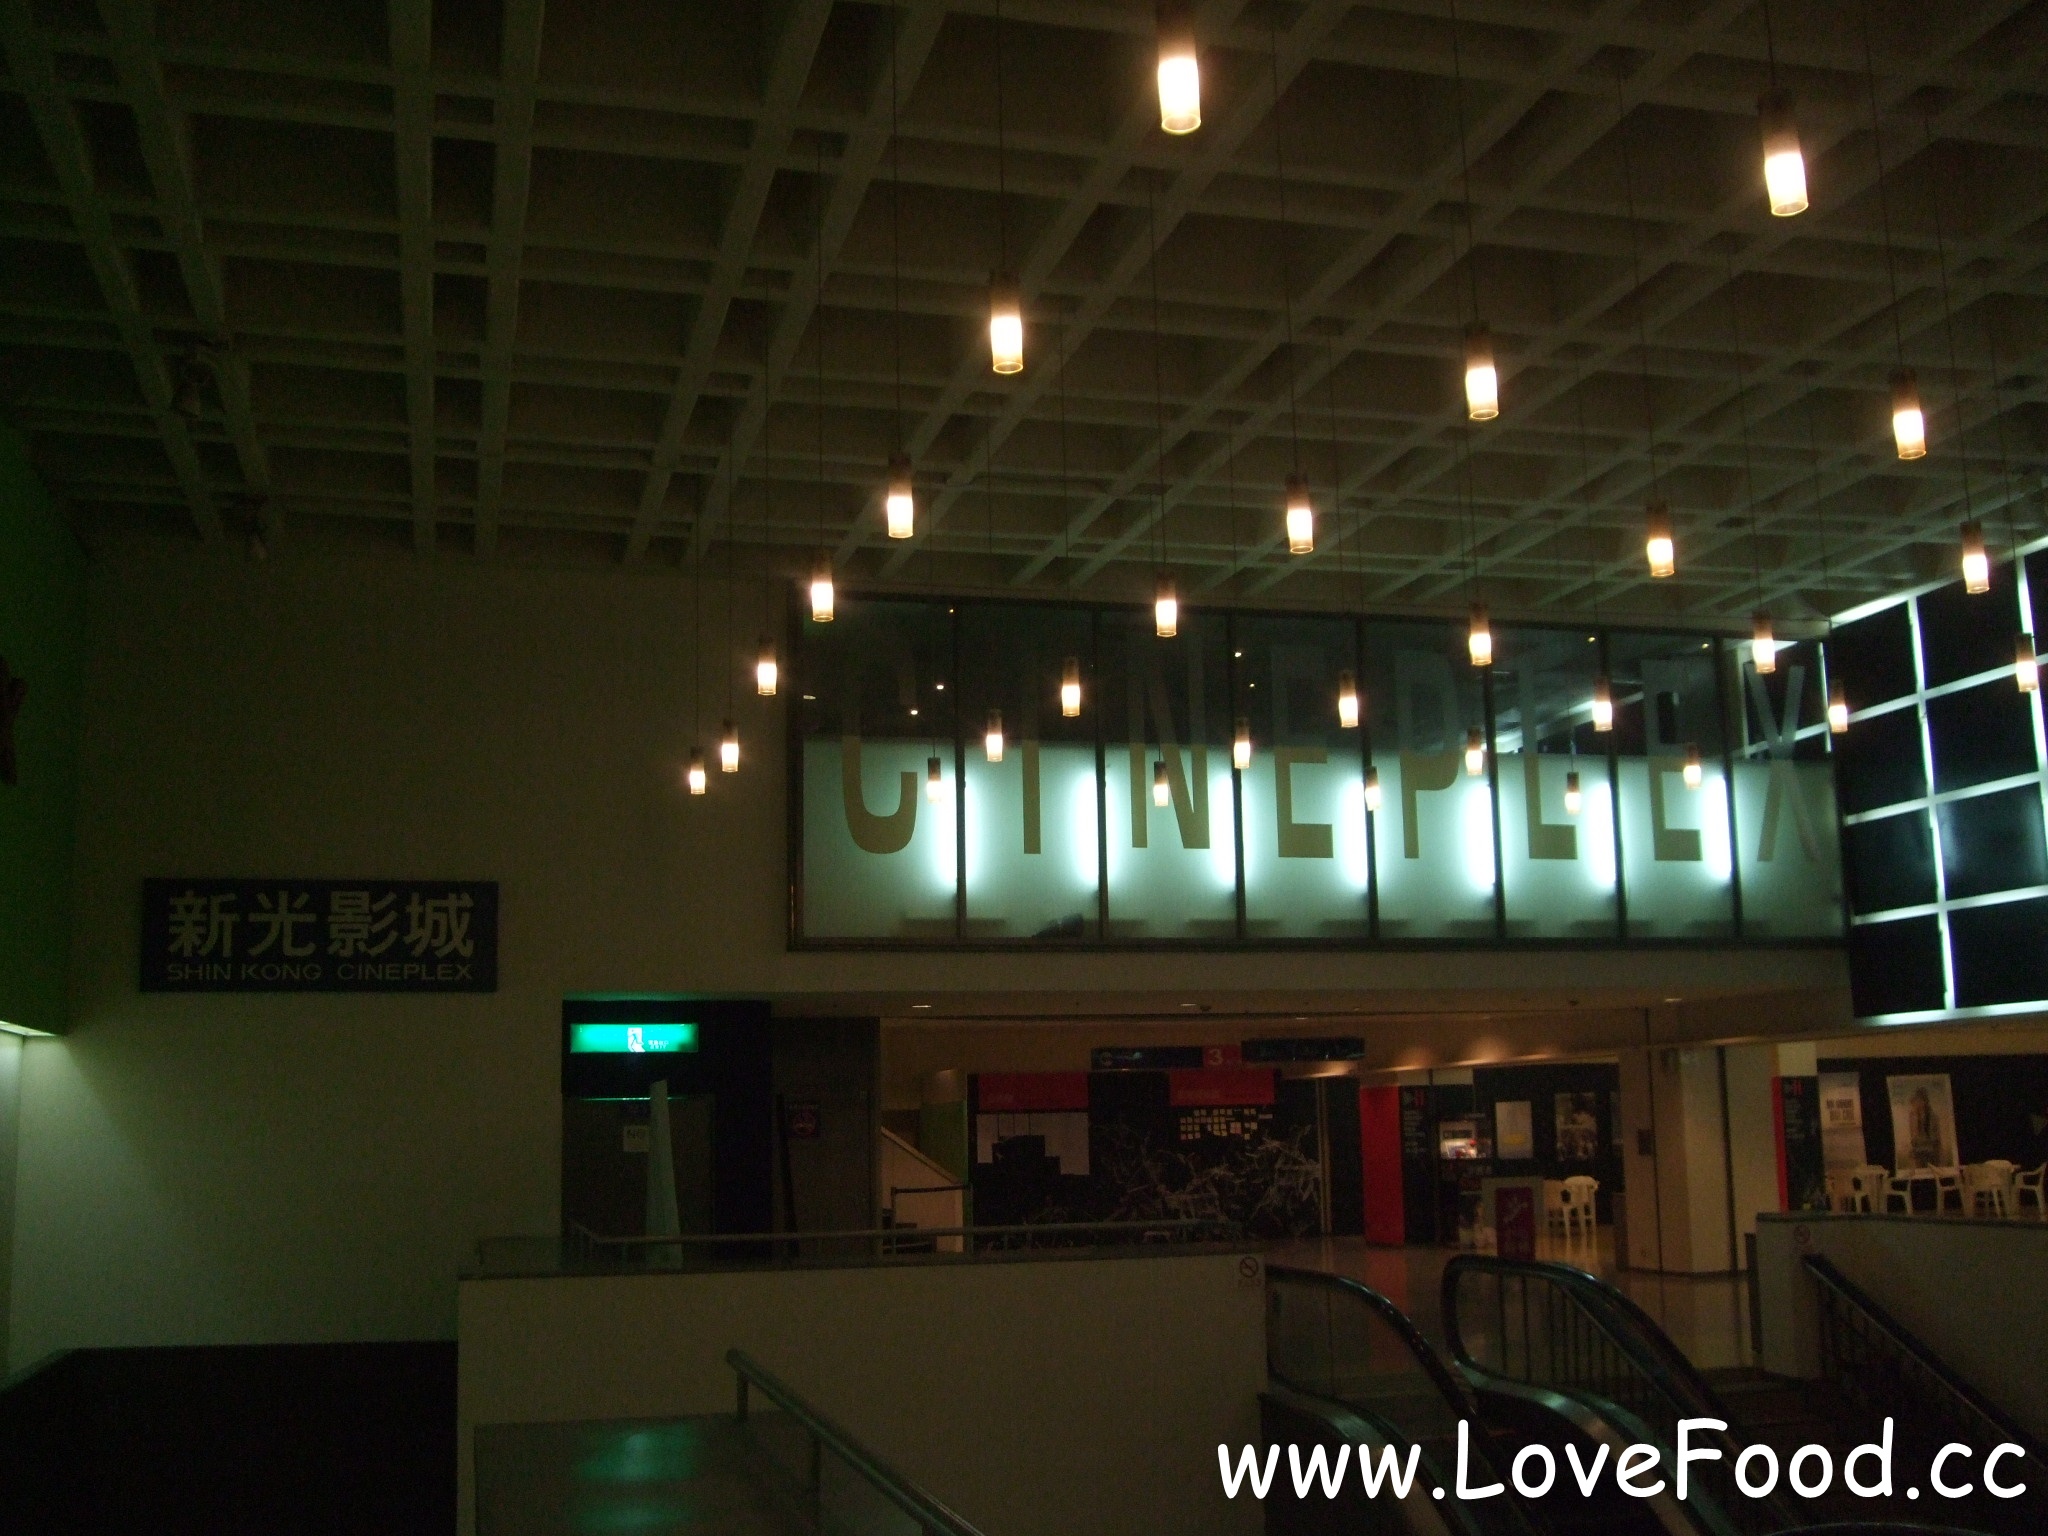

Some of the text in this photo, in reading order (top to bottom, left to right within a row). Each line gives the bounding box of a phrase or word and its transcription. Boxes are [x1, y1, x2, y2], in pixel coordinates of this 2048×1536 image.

[842, 638, 1823, 862] CINEPLEX
[168, 889, 474, 958] 新光影城
[167, 963, 473, 981] SHIN KONG CINEPLEX
